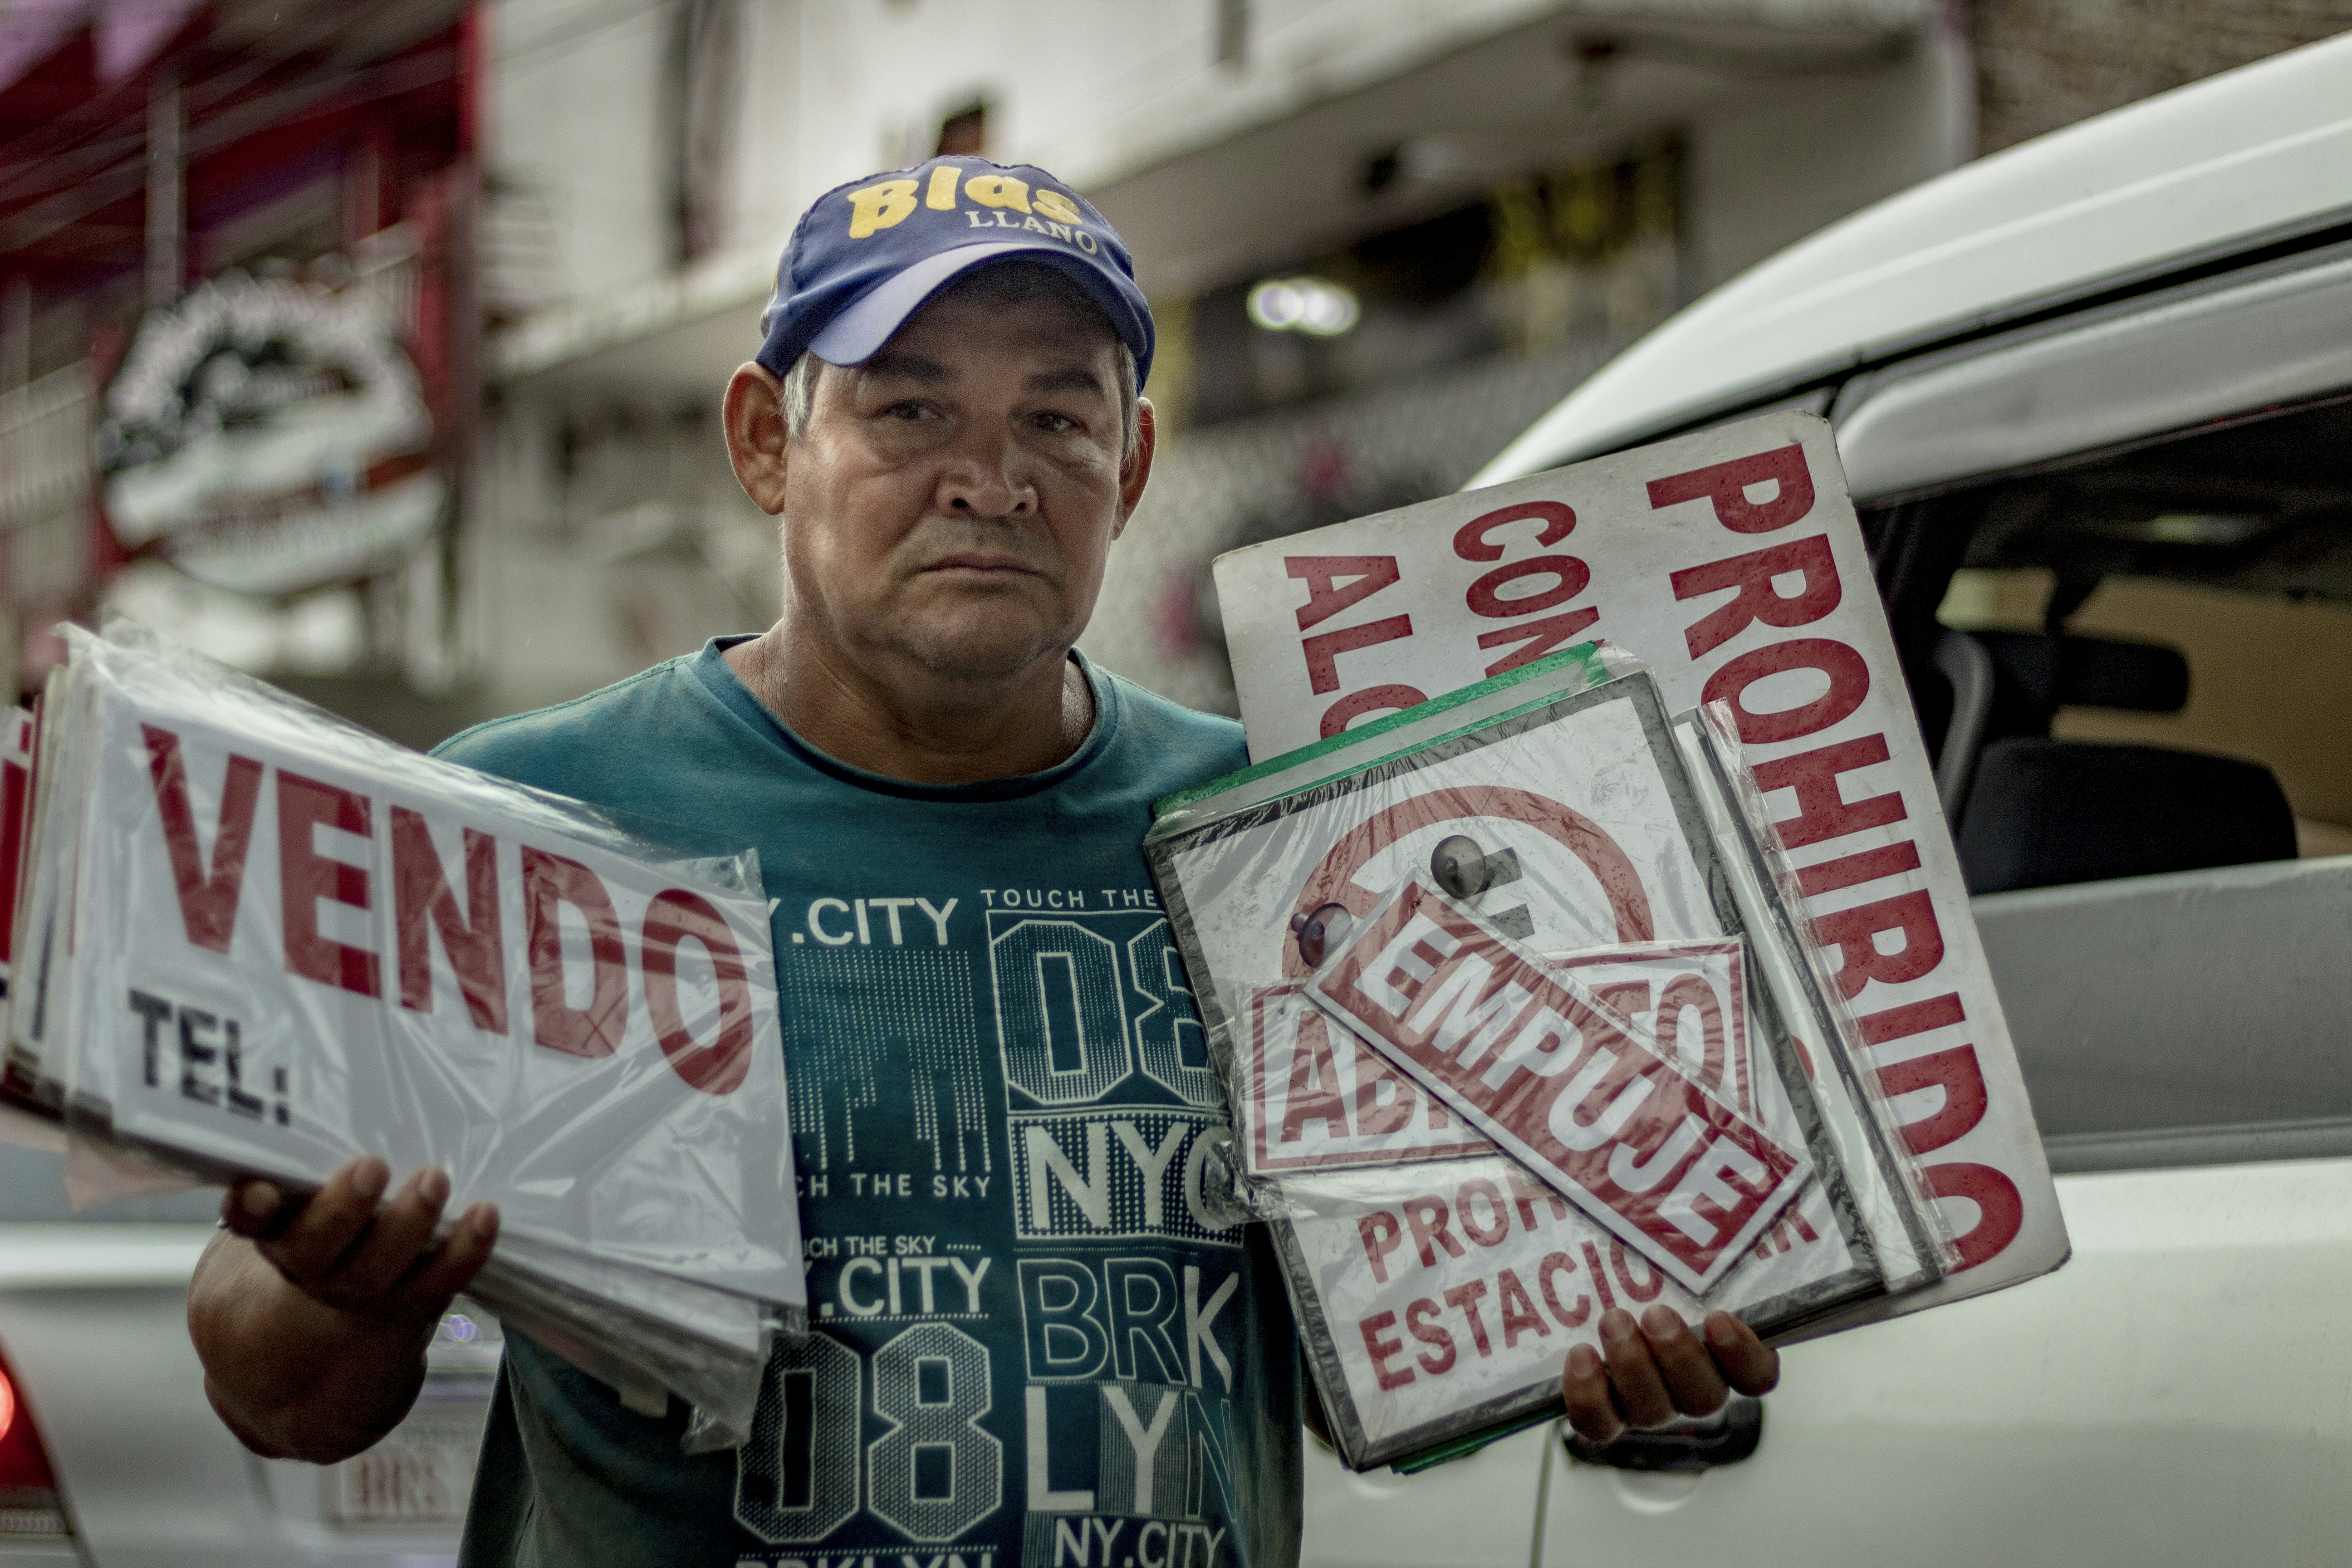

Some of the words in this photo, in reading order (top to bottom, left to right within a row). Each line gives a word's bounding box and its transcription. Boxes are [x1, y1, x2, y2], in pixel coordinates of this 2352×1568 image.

[847, 166, 1082, 239] Blas
[965, 211, 1097, 255] LLANO
[140, 723, 755, 1096] VENDO
[769, 897, 959, 946] .CITY
[980, 889, 1085, 908] TOUCH
[1102, 889, 1157, 907] THE
[1352, 911, 1770, 1248] EMPUJE
[850, 1173, 912, 1197] THE
[932, 1174, 991, 1198] SKY
[845, 1235, 889, 1257] THE
[894, 1235, 936, 1257] SKY
[804, 1256, 992, 1317] .CITY
[1016, 1257, 1239, 1395] BRK
[733, 1322, 1002, 1543] 08
[1025, 1384, 1238, 1524] LYN
[1054, 1518, 1226, 1568] NY.CITY
